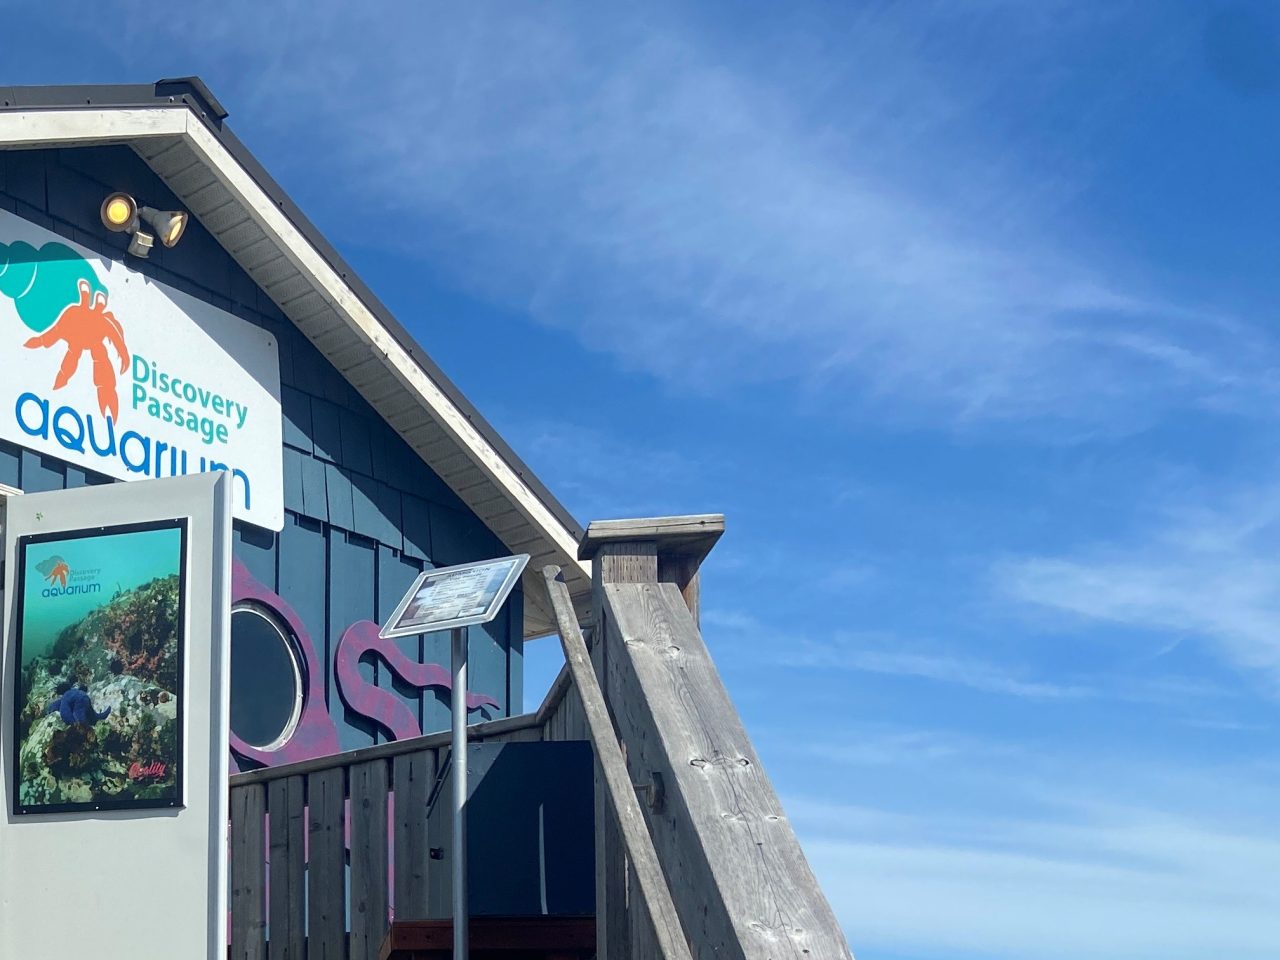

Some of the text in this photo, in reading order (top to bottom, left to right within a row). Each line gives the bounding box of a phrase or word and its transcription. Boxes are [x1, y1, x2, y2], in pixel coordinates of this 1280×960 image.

[132, 355, 248, 429] Discovery
[132, 383, 228, 445] Passage
[42, 583, 101, 598] aquarium
